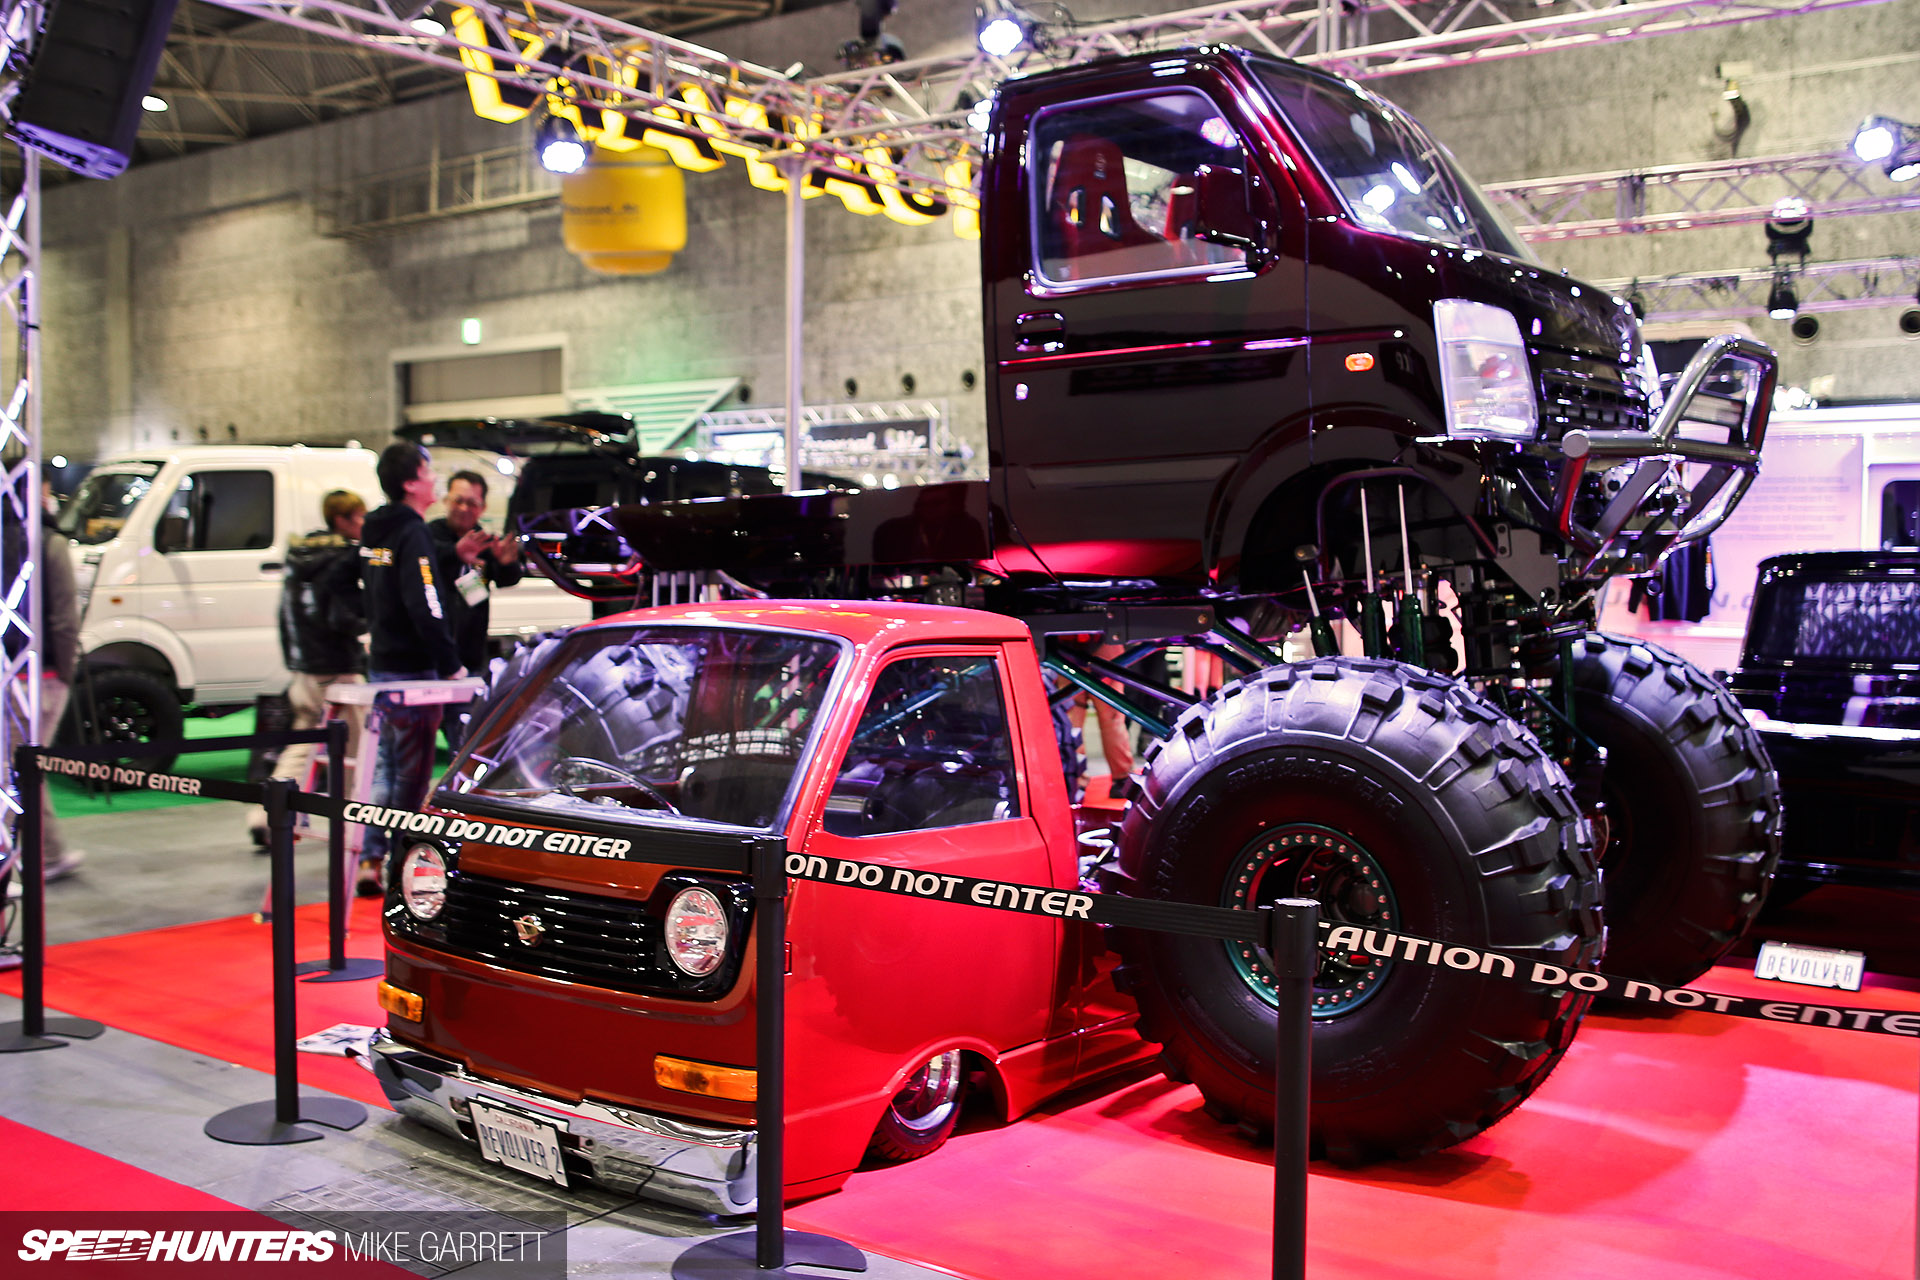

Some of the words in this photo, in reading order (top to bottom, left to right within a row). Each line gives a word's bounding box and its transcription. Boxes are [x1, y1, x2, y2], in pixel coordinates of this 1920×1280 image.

[88, 763, 111, 780] DO
[113, 767, 146, 787] NOT
[148, 773, 202, 796] ENTER
[343, 803, 445, 835] CAUTION
[446, 819, 486, 840] DO
[485, 824, 544, 848] NOT
[543, 832, 632, 860] ENTER
[835, 860, 884, 886] DO
[890, 869, 964, 898] NOT
[970, 882, 1094, 919] ENTER
[1766, 955, 1853, 983] REVOLVER
[1531, 962, 1608, 992] DO
[1624, 980, 1744, 1012] NOT
[1759, 1002, 1920, 1036] ENTE
[479, 1122, 549, 1171] REVOLVER
[551, 1145, 564, 1176] 2
